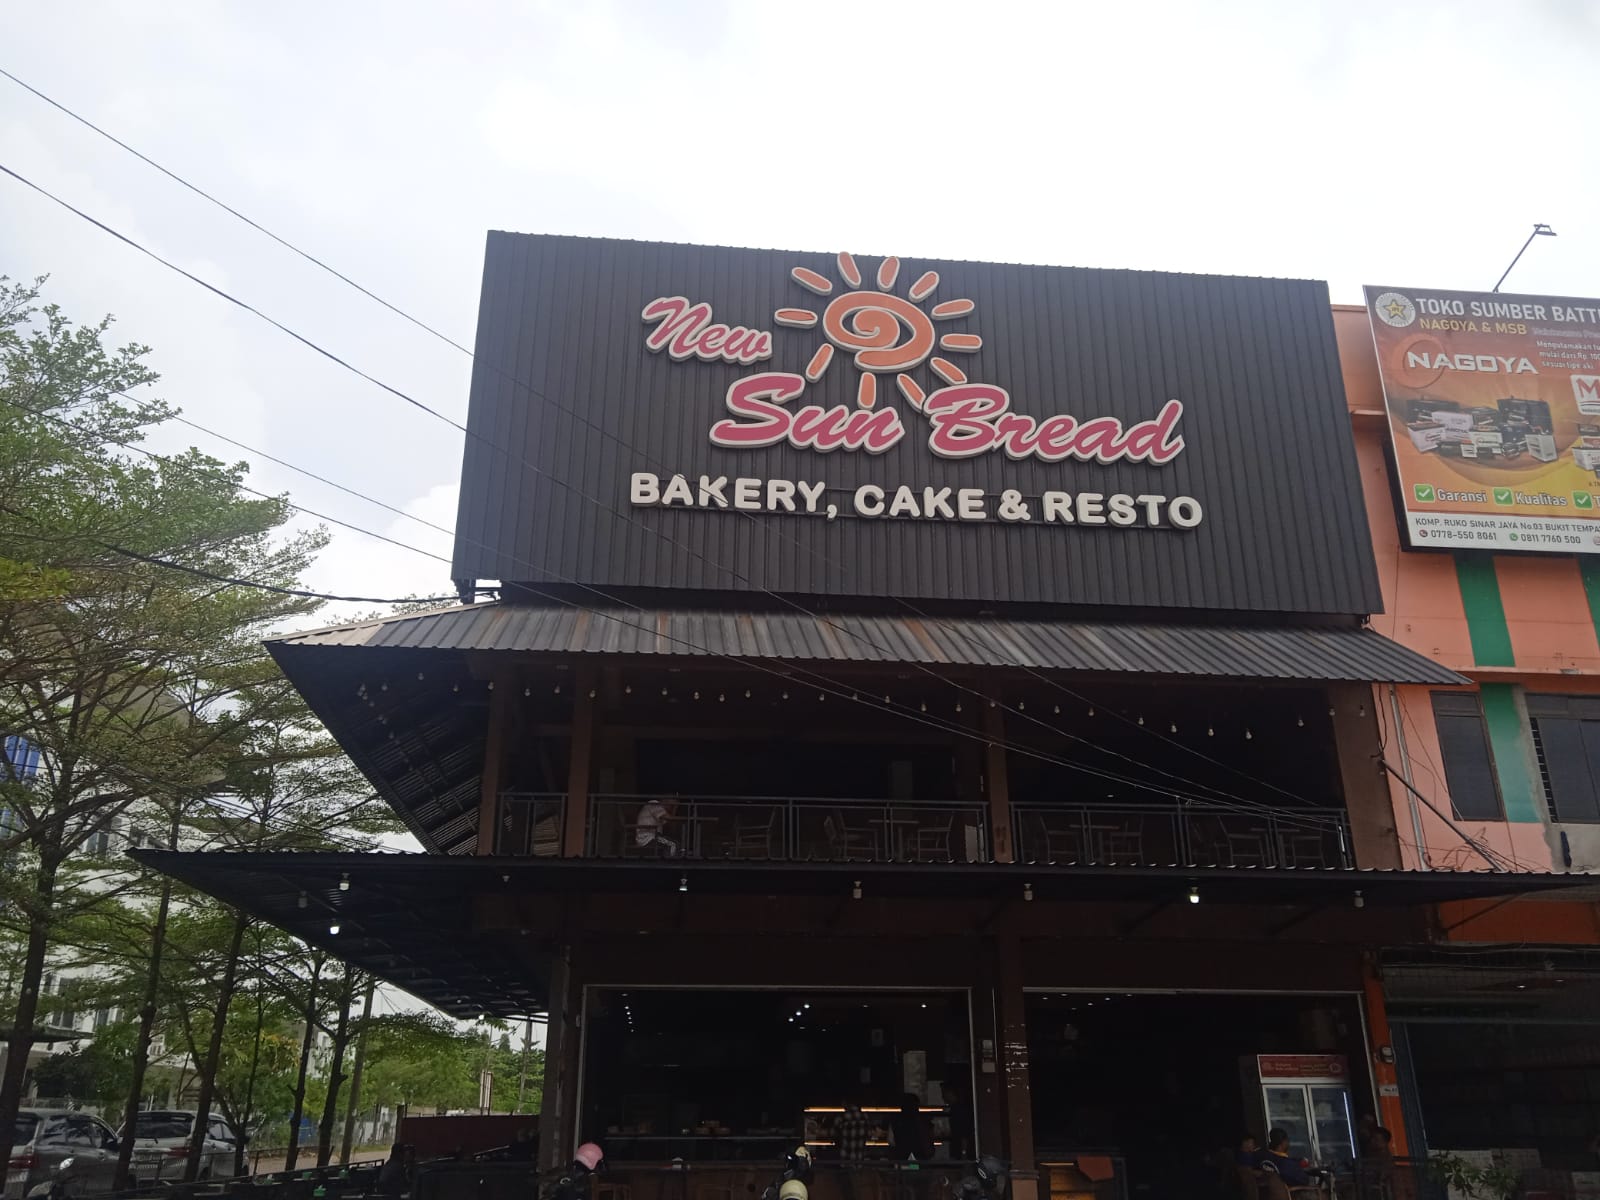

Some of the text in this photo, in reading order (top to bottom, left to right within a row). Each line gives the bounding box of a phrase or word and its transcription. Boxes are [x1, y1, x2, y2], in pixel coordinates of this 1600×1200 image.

[1415, 298, 1465, 316] TOKO
[1470, 301, 1548, 321] SUMBER
[1552, 306, 1600, 324] BATT
[642, 296, 773, 364] New
[1419, 318, 1477, 332] NAGOYA
[1481, 322, 1491, 333] &
[1495, 322, 1527, 335] MSB
[1407, 351, 1538, 374] NAGOYA
[709, 371, 1185, 465] Sun Bread
[630, 471, 1203, 530] BAKERY, CAKE & RESTO
[1437, 489, 1487, 503] Garansi
[1515, 491, 1568, 506] Kualitas
[1444, 519, 1467, 527] RUKO
[1470, 520, 1496, 528] SINAR
[1498, 521, 1518, 529] JAYA
[1545, 523, 1570, 531] BUKIT
[1431, 530, 1581, 544] 0778-550 8061 0811 7760 500
